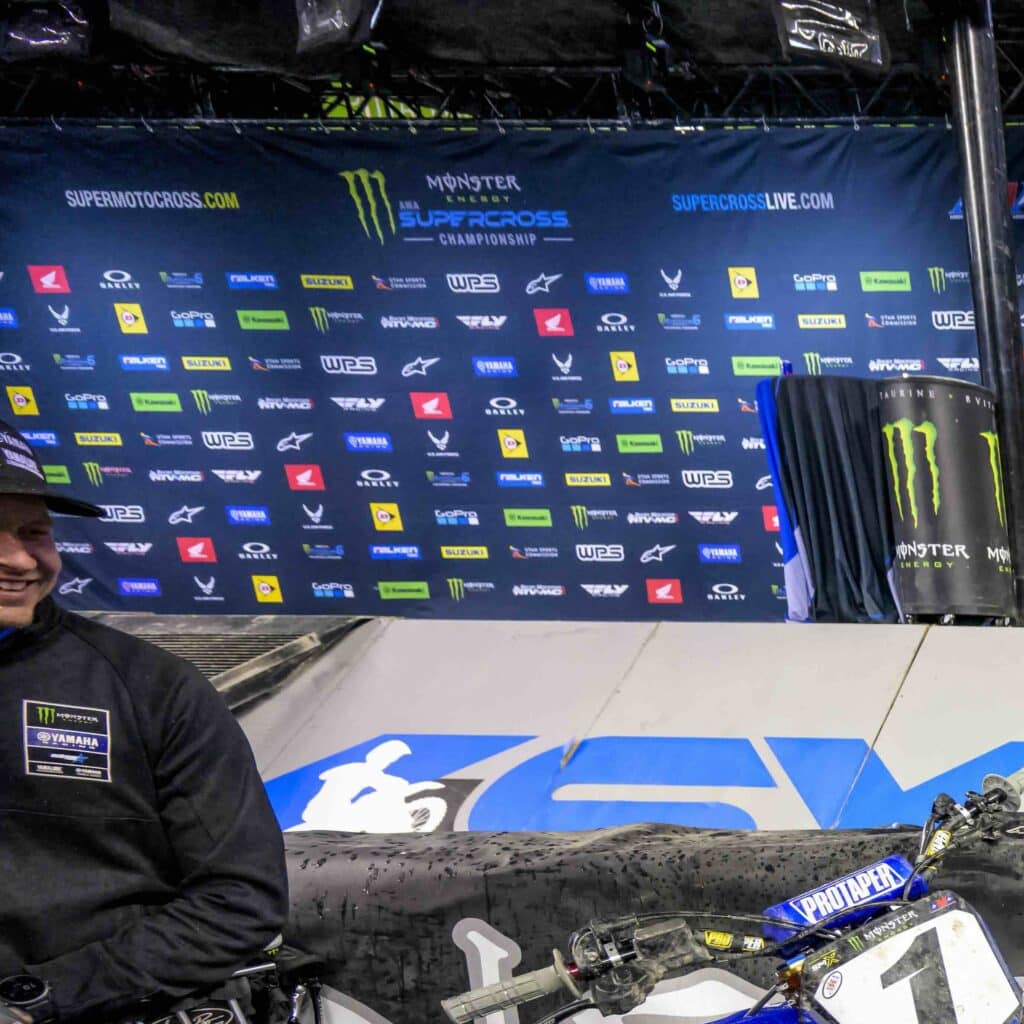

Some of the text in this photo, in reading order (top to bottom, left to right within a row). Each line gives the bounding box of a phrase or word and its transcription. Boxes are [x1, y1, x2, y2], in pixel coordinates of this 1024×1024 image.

[427, 173, 520, 192] MONSTER
[65, 190, 239, 209] SUPERMOTOCROSS.COM
[672, 192, 834, 211] SUPERCROSSLIVE.COM
[400, 210, 571, 228] SUPERCROSS
[439, 233, 537, 246] CHAMPIONSHIP
[305, 278, 348, 287] SUZUKI
[447, 274, 500, 292] WPS
[794, 274, 836, 284] GoPro
[171, 311, 213, 319] GoPro
[802, 317, 842, 326] SUZUKI
[187, 359, 226, 368] SUZUKI
[321, 356, 377, 375] WPS
[666, 358, 708, 366] GoPro
[66, 393, 106, 401] GoPro
[675, 402, 714, 410] SUZUKI
[202, 431, 254, 449] WPS
[682, 470, 733, 488] WPS
[435, 509, 478, 518] GoPro
[445, 548, 484, 557] SUZUKI
[576, 544, 624, 562] WPS
[312, 583, 353, 591] GoPro
[51, 733, 99, 747] YAMAHA
[801, 865, 898, 921] PROTAPER
[863, 910, 919, 941] MONSTER
